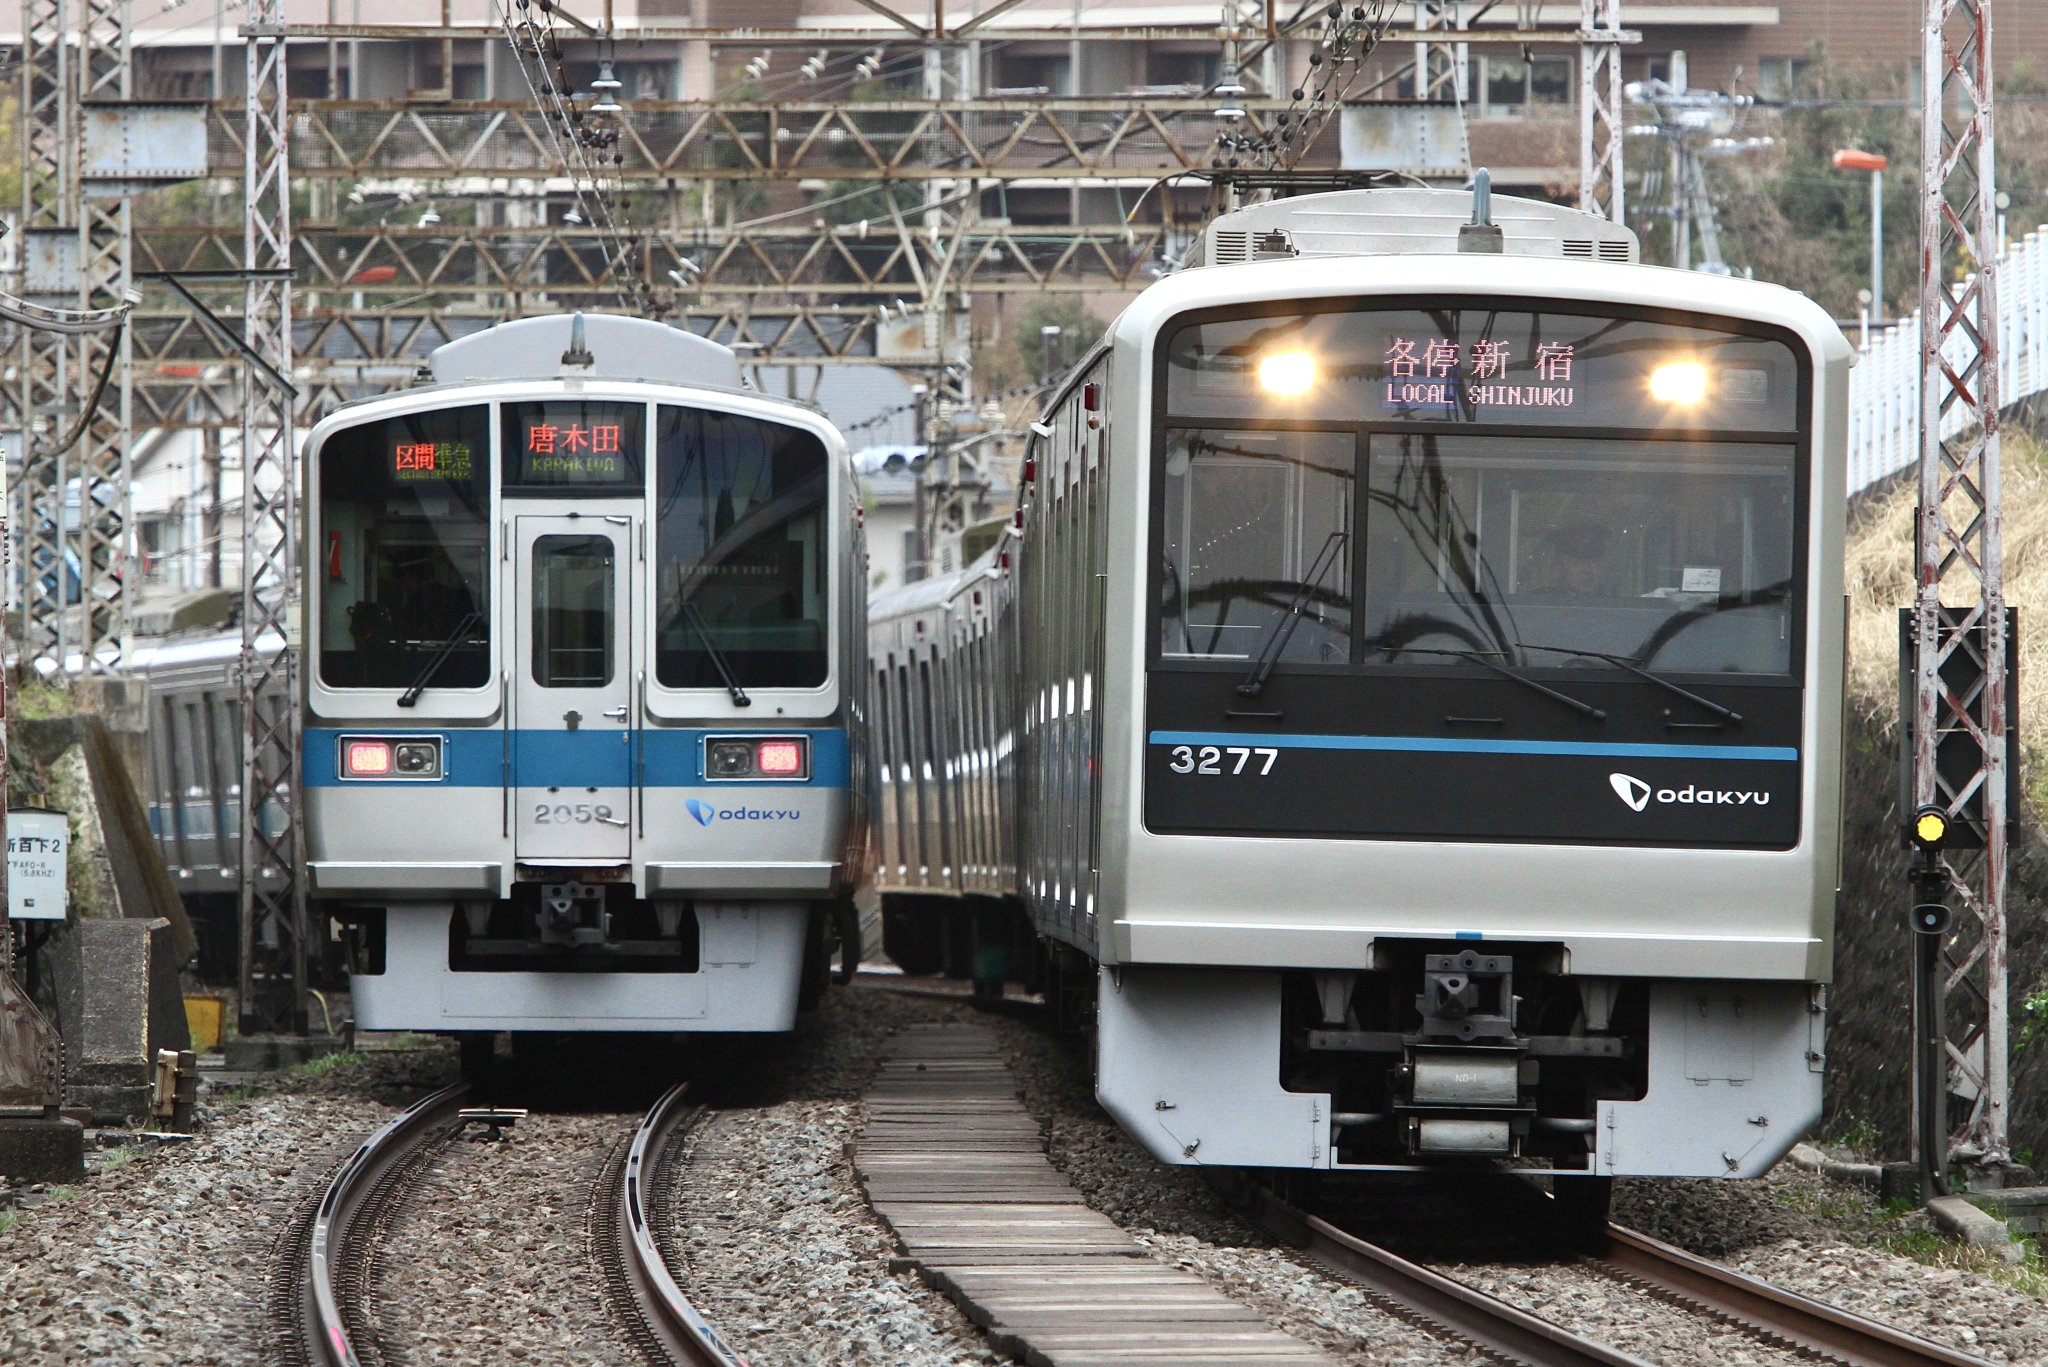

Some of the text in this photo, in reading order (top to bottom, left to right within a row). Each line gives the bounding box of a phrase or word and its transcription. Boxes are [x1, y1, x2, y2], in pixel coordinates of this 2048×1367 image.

[1384, 337, 1574, 381] 各停 新宿
[1387, 383, 1574, 406] LOCAL SHINJUKU
[528, 423, 619, 454] 唐木田
[1168, 745, 1279, 776] 3277
[1656, 784, 1770, 806] odakyu
[534, 804, 613, 824] 2059
[719, 806, 801, 821] odakyu
